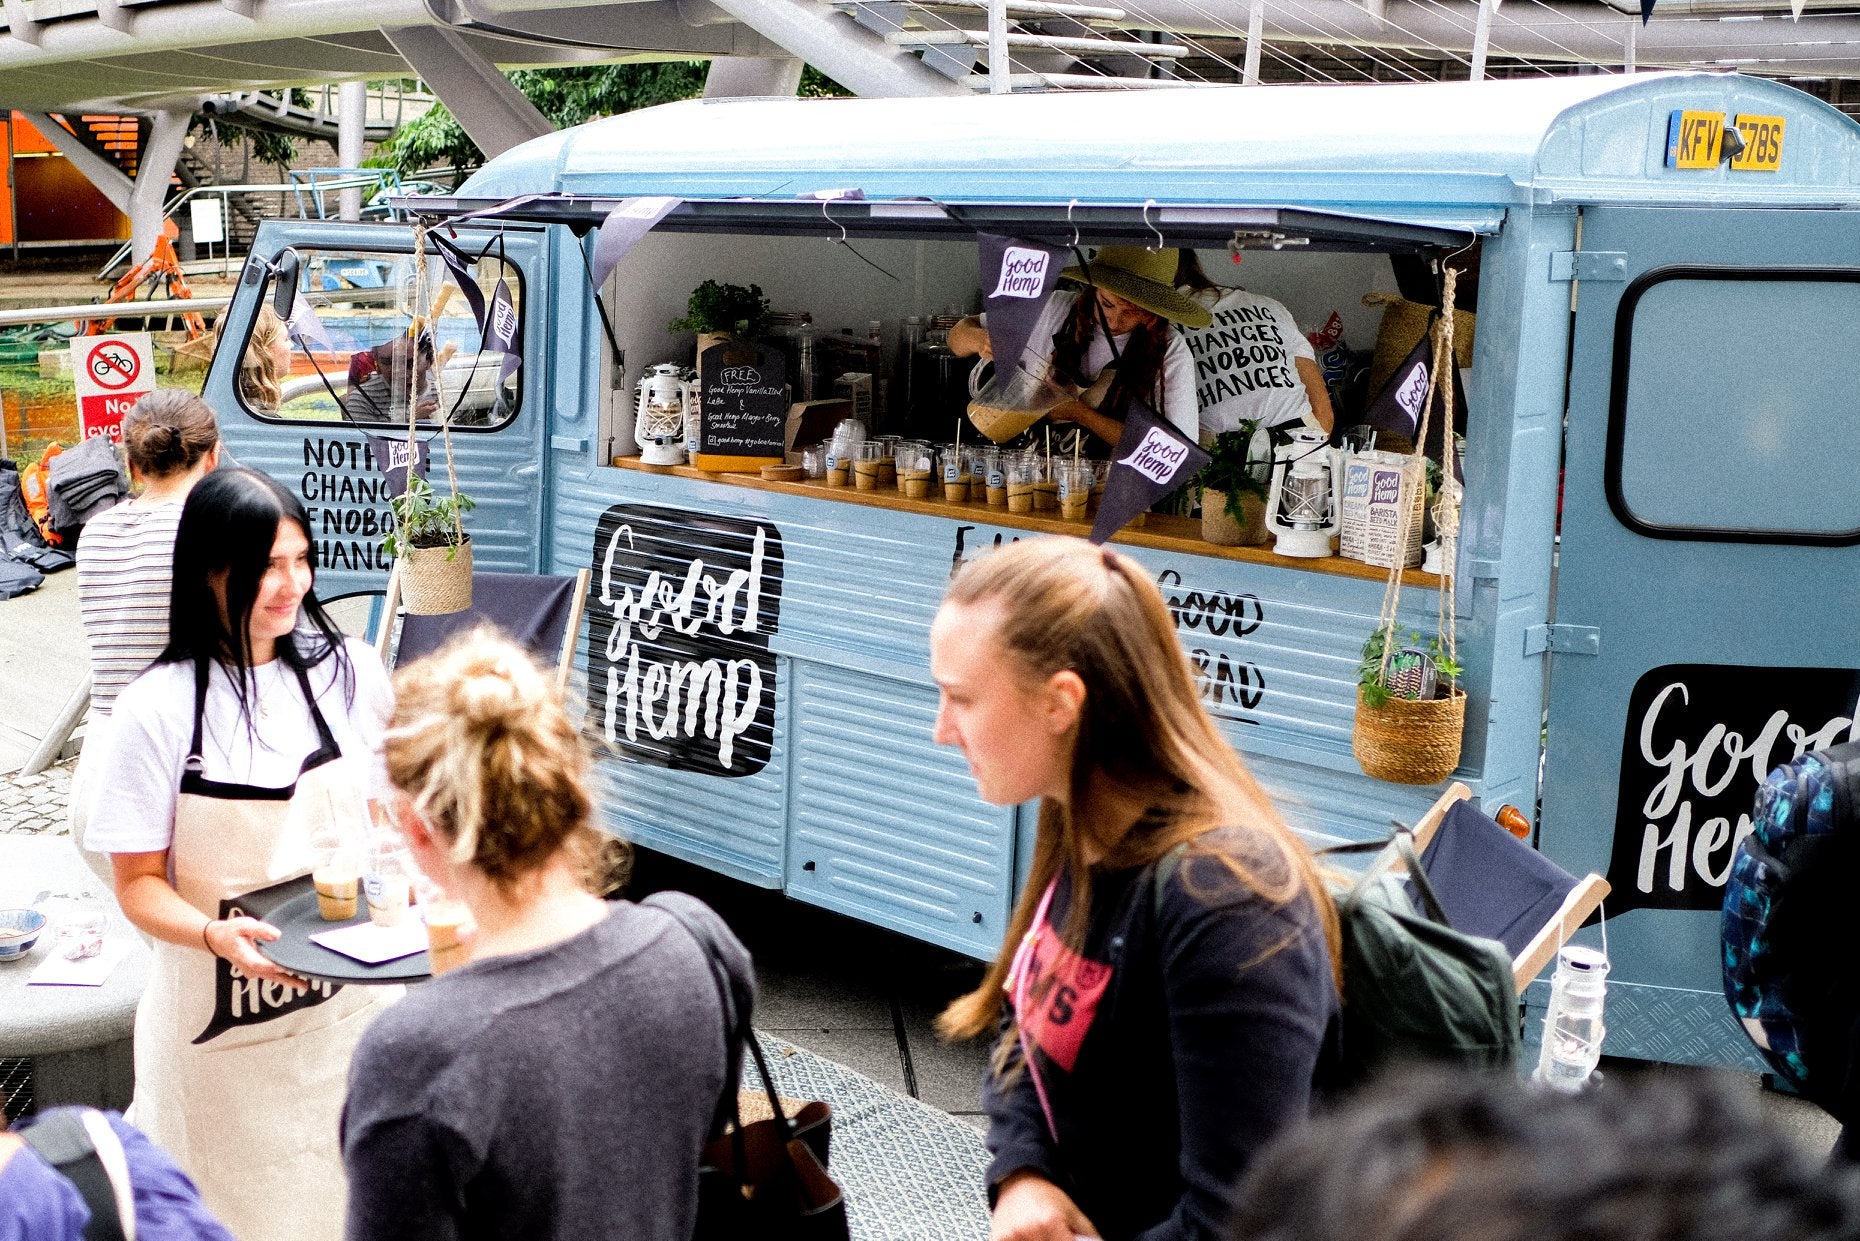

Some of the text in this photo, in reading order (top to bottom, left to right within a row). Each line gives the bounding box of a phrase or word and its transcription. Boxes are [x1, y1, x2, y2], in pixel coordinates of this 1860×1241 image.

[1679, 118, 1719, 161] KFV
[1005, 250, 1046, 277] Good
[1002, 274, 1041, 296] Hemp
[1185, 324, 1284, 358] HANGES
[724, 369, 755, 382] FREE
[1197, 344, 1288, 381] NOBODY
[708, 384, 725, 395] Good
[726, 385, 745, 397] Hemp
[1195, 366, 1295, 413] HANGES
[1400, 364, 1426, 412] Good
[105, 399, 131, 415] No
[707, 412, 723, 422] Good
[723, 412, 741, 423] Hemp
[1141, 430, 1186, 463] Good
[1132, 451, 1173, 480] Hemp
[1349, 467, 1369, 484] Good
[1374, 472, 1399, 490] Good
[1374, 487, 1398, 503] Hemp
[323, 507, 395, 537] NOBO
[1370, 507, 1398, 519] BARISTA
[313, 539, 394, 572] HANG
[599, 524, 766, 663] Good
[1157, 570, 1263, 637] GOOD
[604, 643, 763, 768] Hemp
[1637, 800, 1755, 893] He
